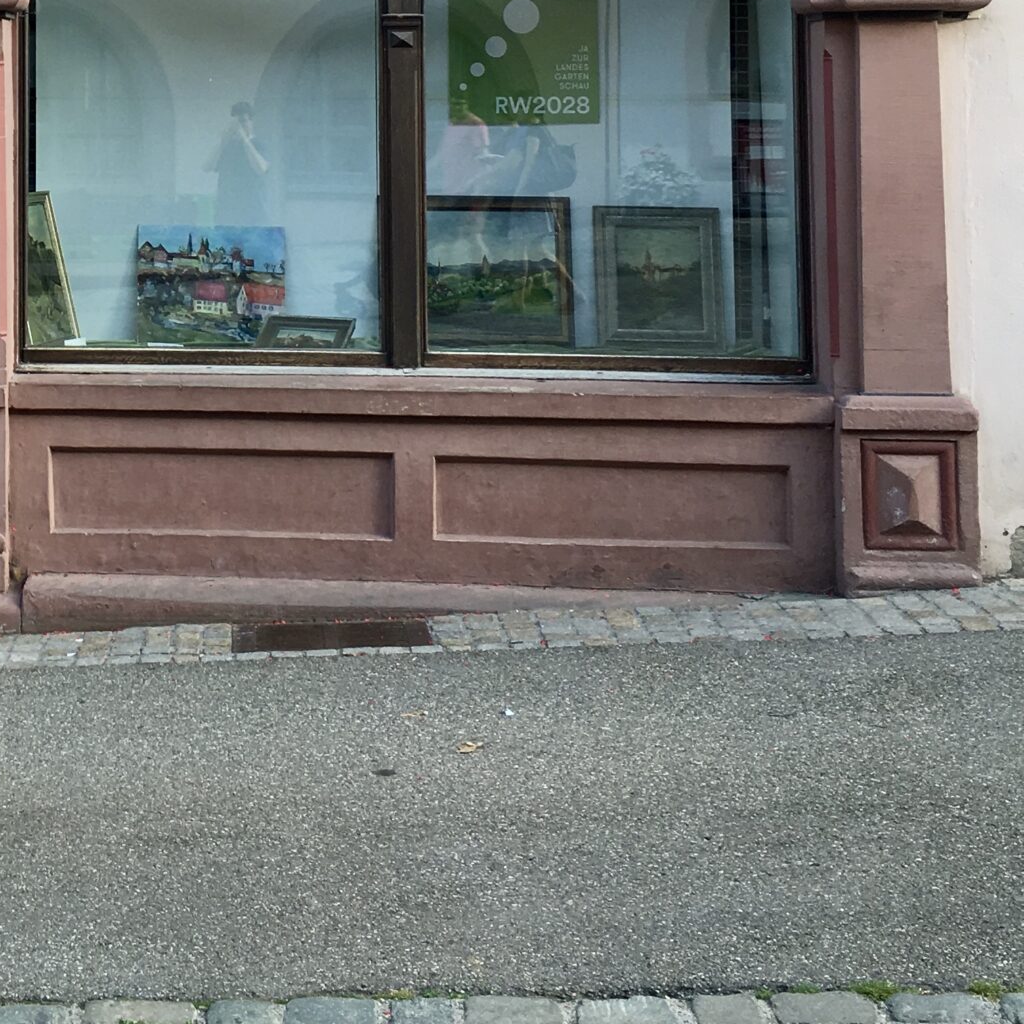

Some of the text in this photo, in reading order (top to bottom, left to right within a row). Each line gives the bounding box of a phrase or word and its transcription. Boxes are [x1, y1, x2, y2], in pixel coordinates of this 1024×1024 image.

[571, 54, 589, 62] ZUR
[555, 63, 589, 71] LANDES
[554, 72, 589, 81] GARTEN
[559, 82, 590, 90] SCHAU
[495, 96, 590, 114] RW2028
